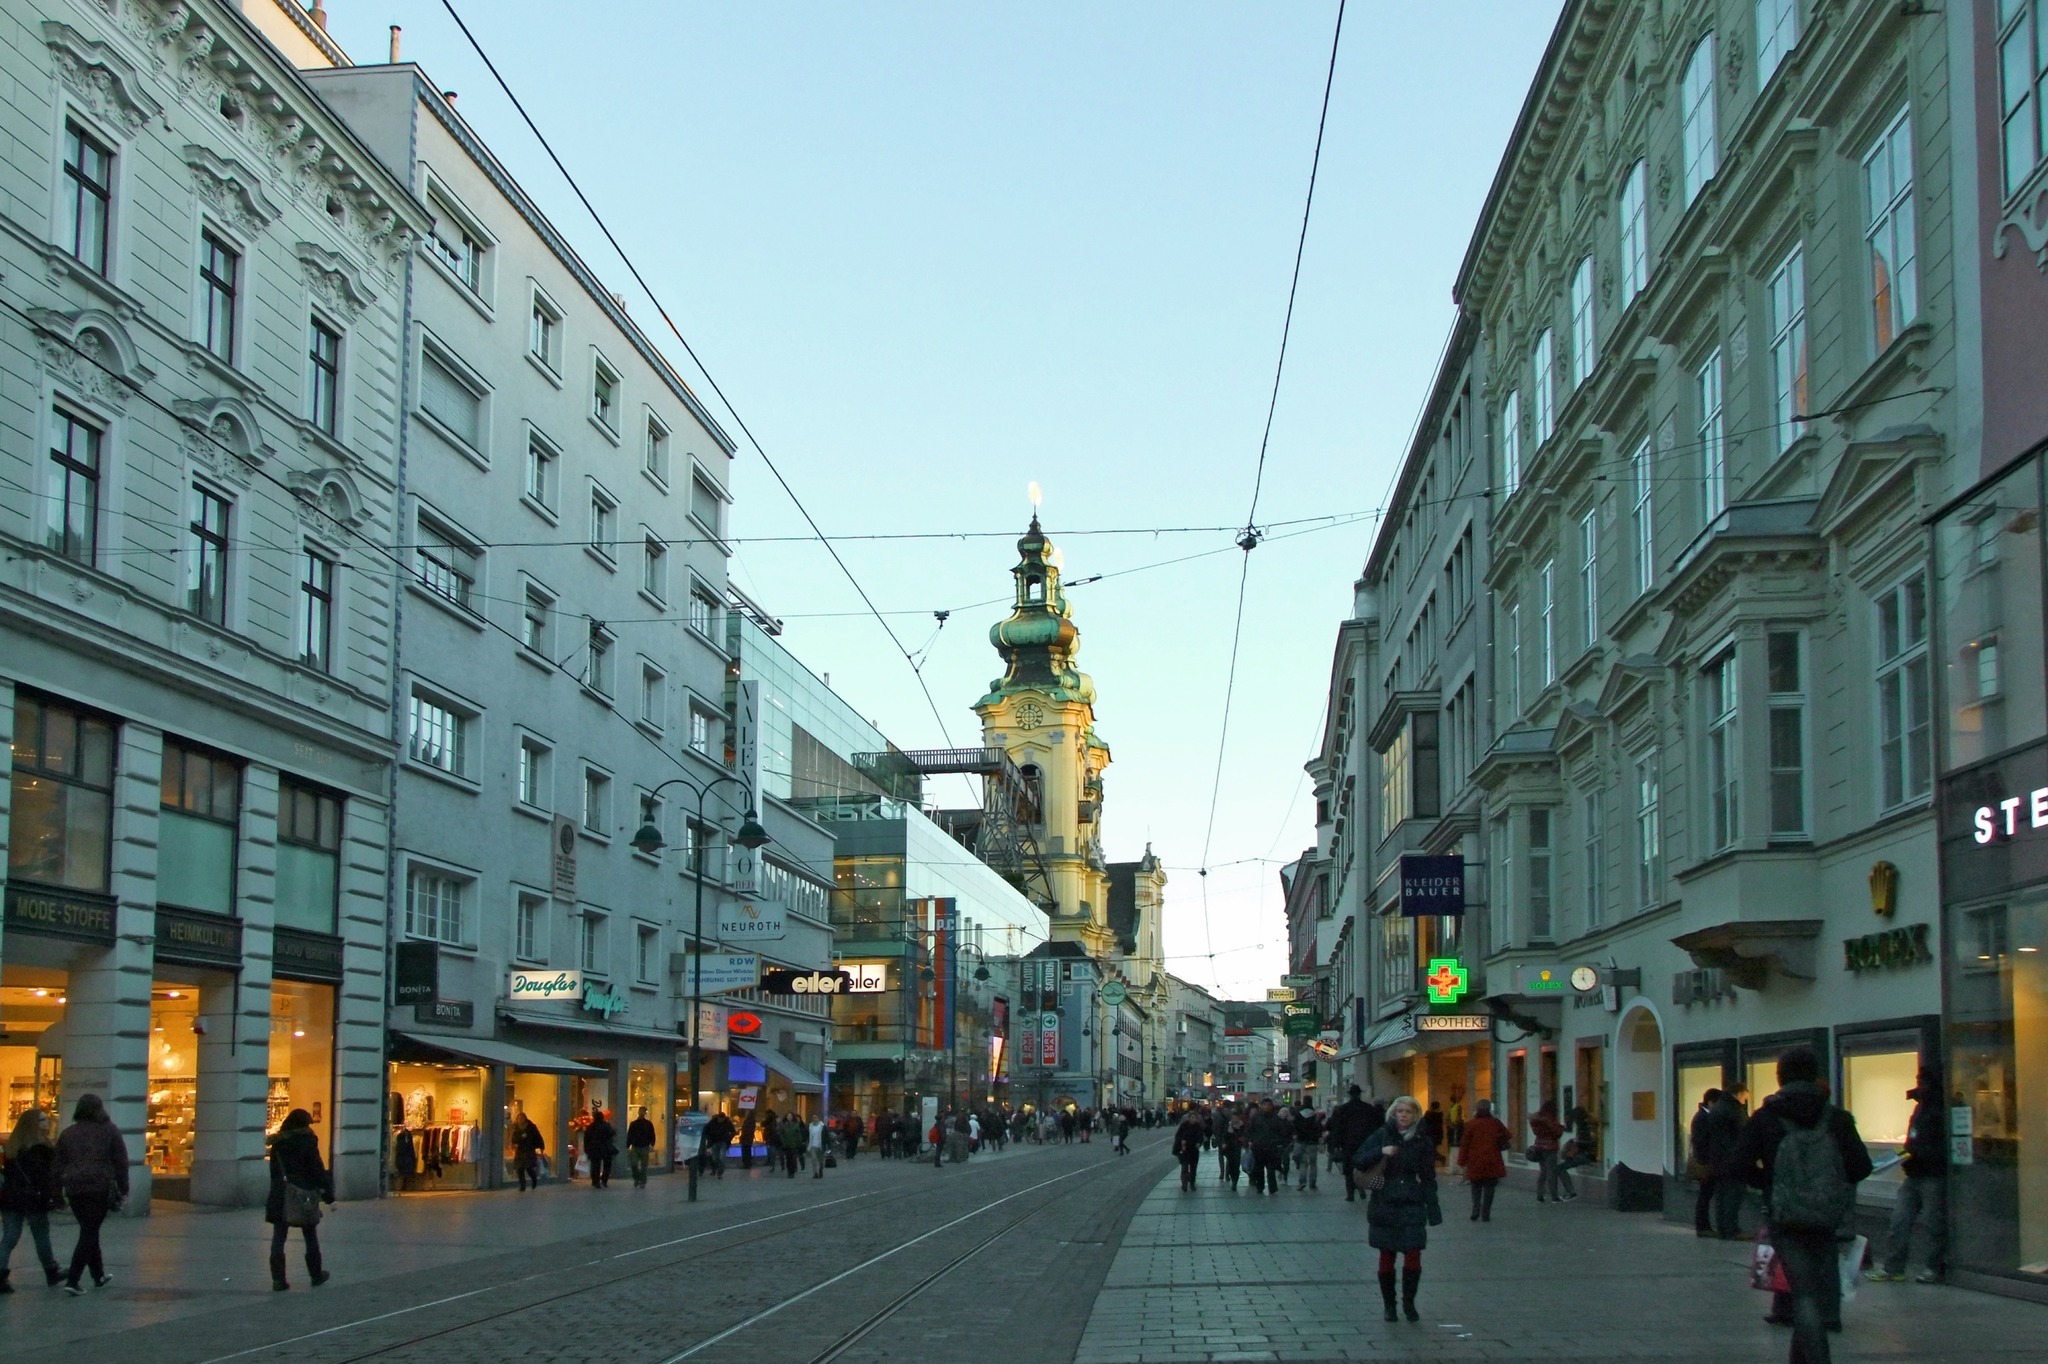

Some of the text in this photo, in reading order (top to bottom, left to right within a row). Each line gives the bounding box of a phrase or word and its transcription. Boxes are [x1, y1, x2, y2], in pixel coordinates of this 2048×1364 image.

[738, 683, 754, 874] VALENTO
[1974, 786, 2048, 844] STE
[1405, 877, 1460, 887] KLEIDER
[1405, 886, 1460, 897] BAUER
[721, 921, 781, 932] NEUROTH
[730, 957, 755, 966] RDW
[1045, 960, 1054, 991] SATURN
[513, 973, 577, 997] Douglas
[792, 971, 843, 993] eiler
[1528, 981, 1563, 990] ROLEX
[400, 985, 431, 994] BONITA
[436, 1004, 461, 1018] BONITA
[1420, 1017, 1487, 1029] APOTHEKE
